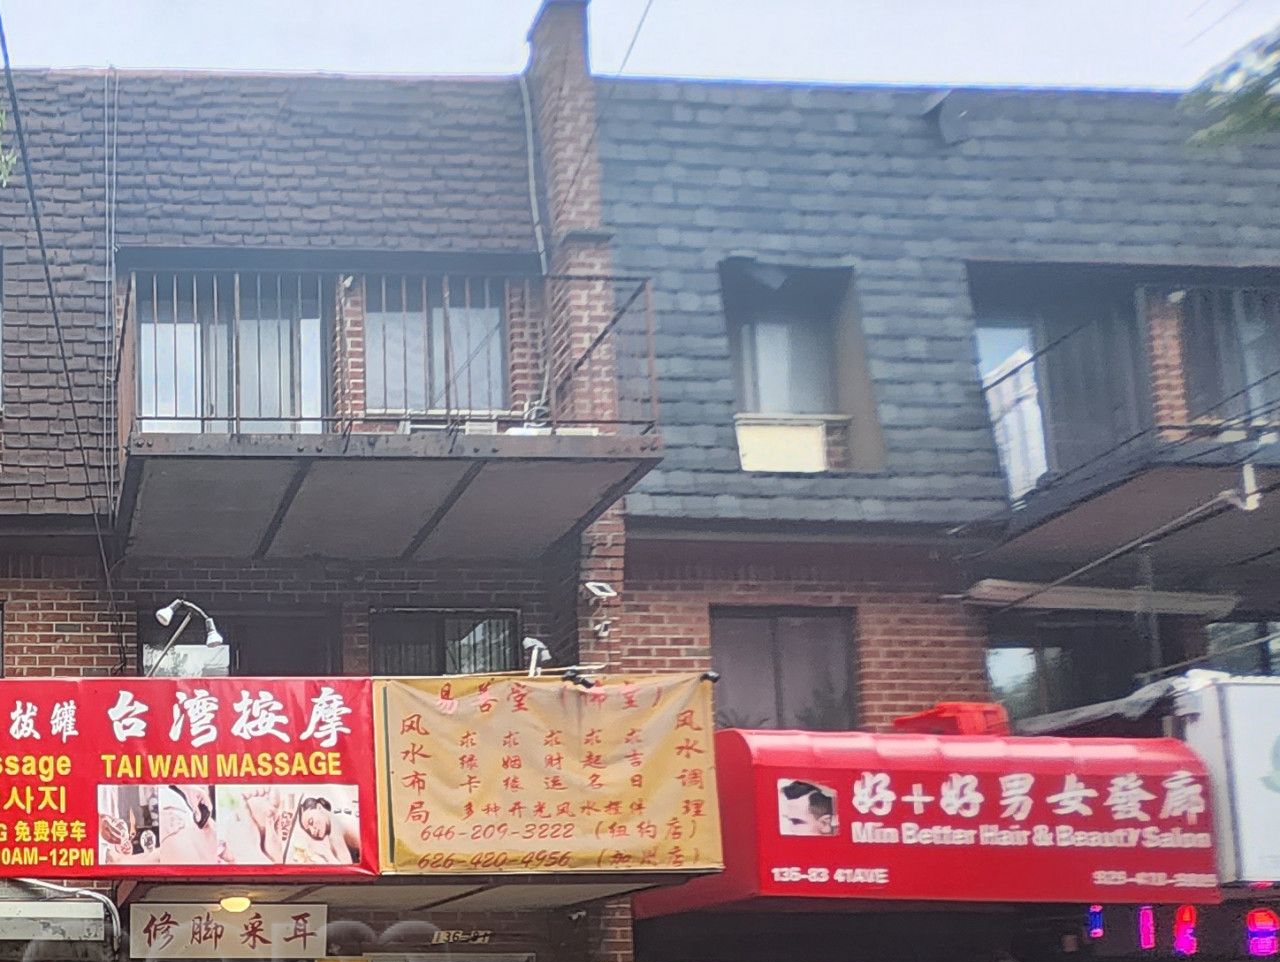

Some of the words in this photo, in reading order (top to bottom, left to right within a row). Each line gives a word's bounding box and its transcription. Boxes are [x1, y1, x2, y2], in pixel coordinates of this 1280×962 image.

[107, 686, 352, 748] 台湾按摩
[216, 751, 342, 777] MASSAGE
[400, 713, 432, 824] 风水布局
[14, 820, 87, 843] 免费停车
[420, 823, 575, 842] 646-209-3222
[901, 822, 977, 845] Better
[978, 824, 1031, 846] Hair
[418, 850, 571, 870] 626-420-4956
[143, 911, 317, 951] 修脚采耳
